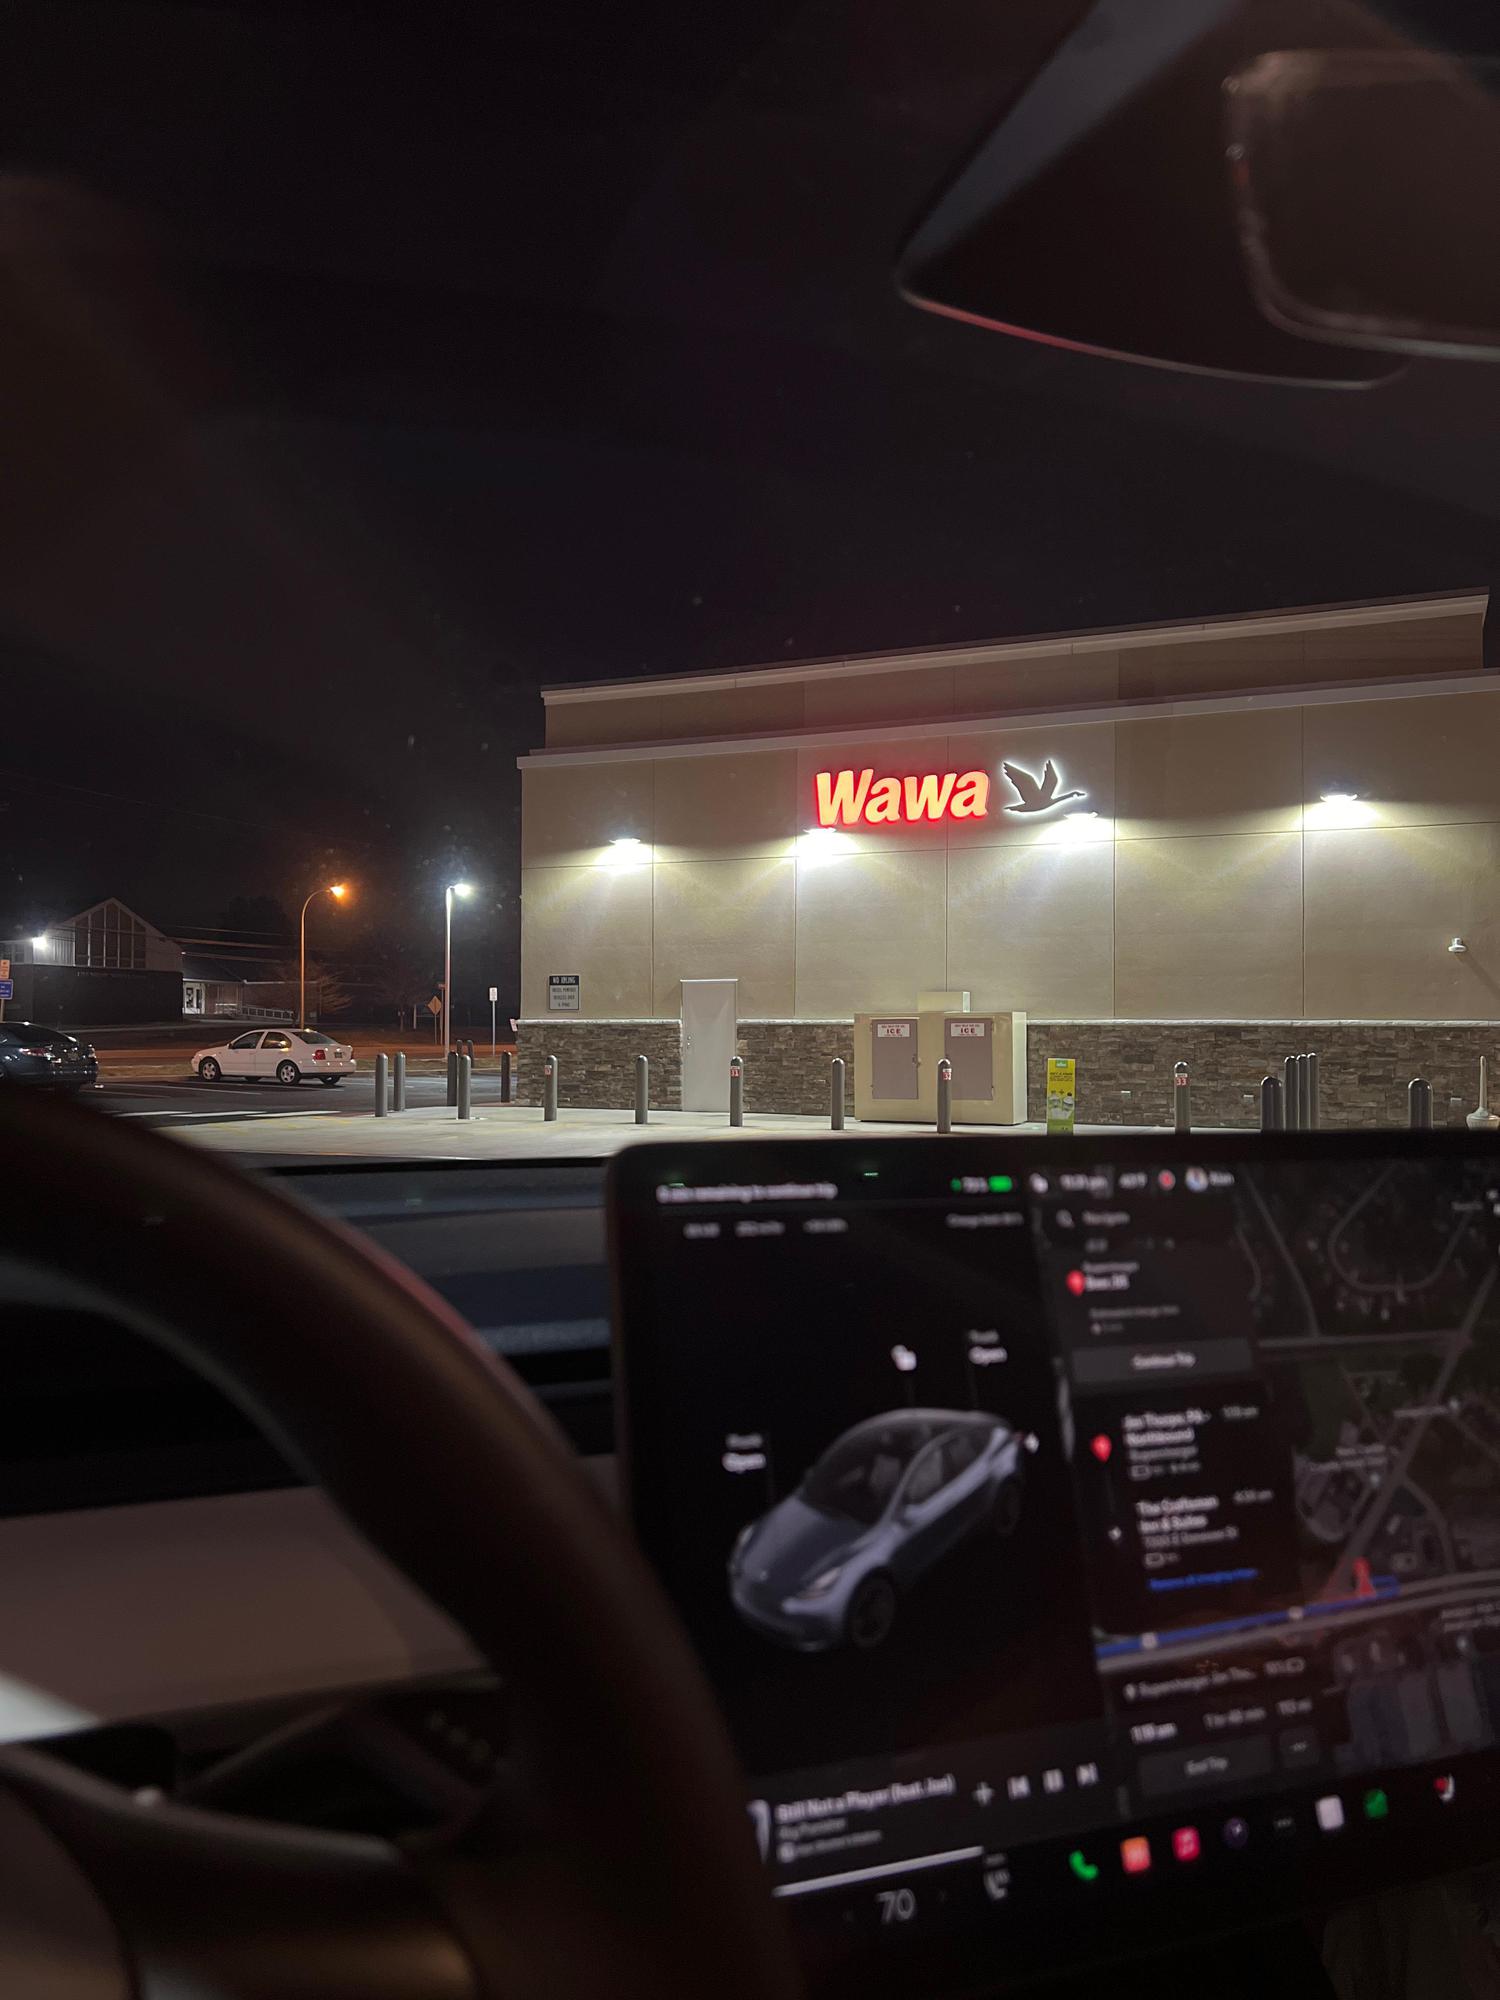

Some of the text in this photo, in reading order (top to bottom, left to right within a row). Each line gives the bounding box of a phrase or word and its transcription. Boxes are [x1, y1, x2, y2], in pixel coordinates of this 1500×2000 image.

[816, 768, 989, 826] Wawa
[1176, 1077, 1187, 1085] 33
[876, 1888, 916, 1922] 70
